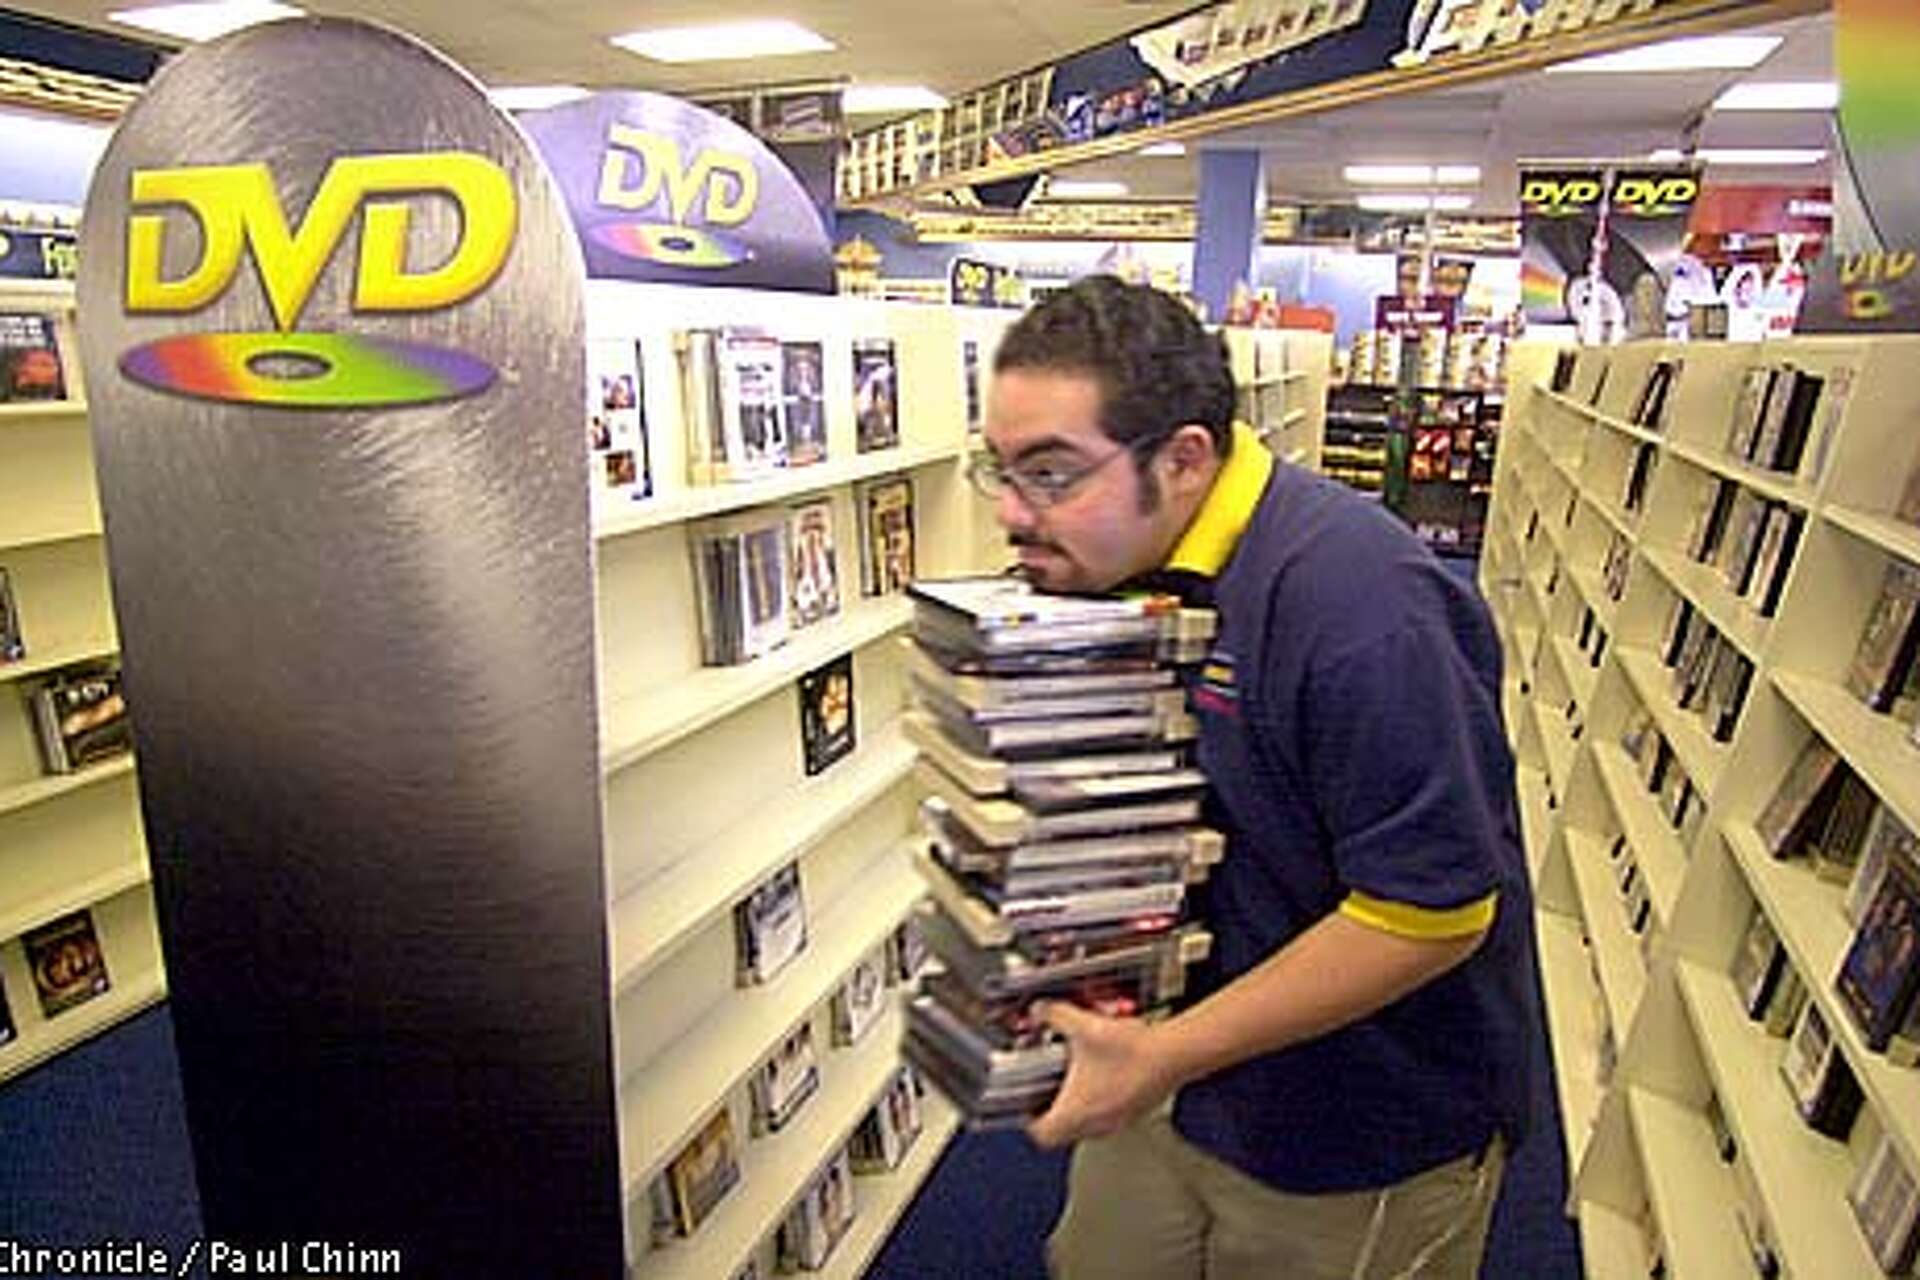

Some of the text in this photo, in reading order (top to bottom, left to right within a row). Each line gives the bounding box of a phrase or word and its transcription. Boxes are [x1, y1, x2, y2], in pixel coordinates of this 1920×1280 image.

[597, 122, 759, 227] DVD
[1522, 179, 1601, 206] DVD
[1613, 178, 1697, 206] DVD
[125, 150, 518, 334] DVD
